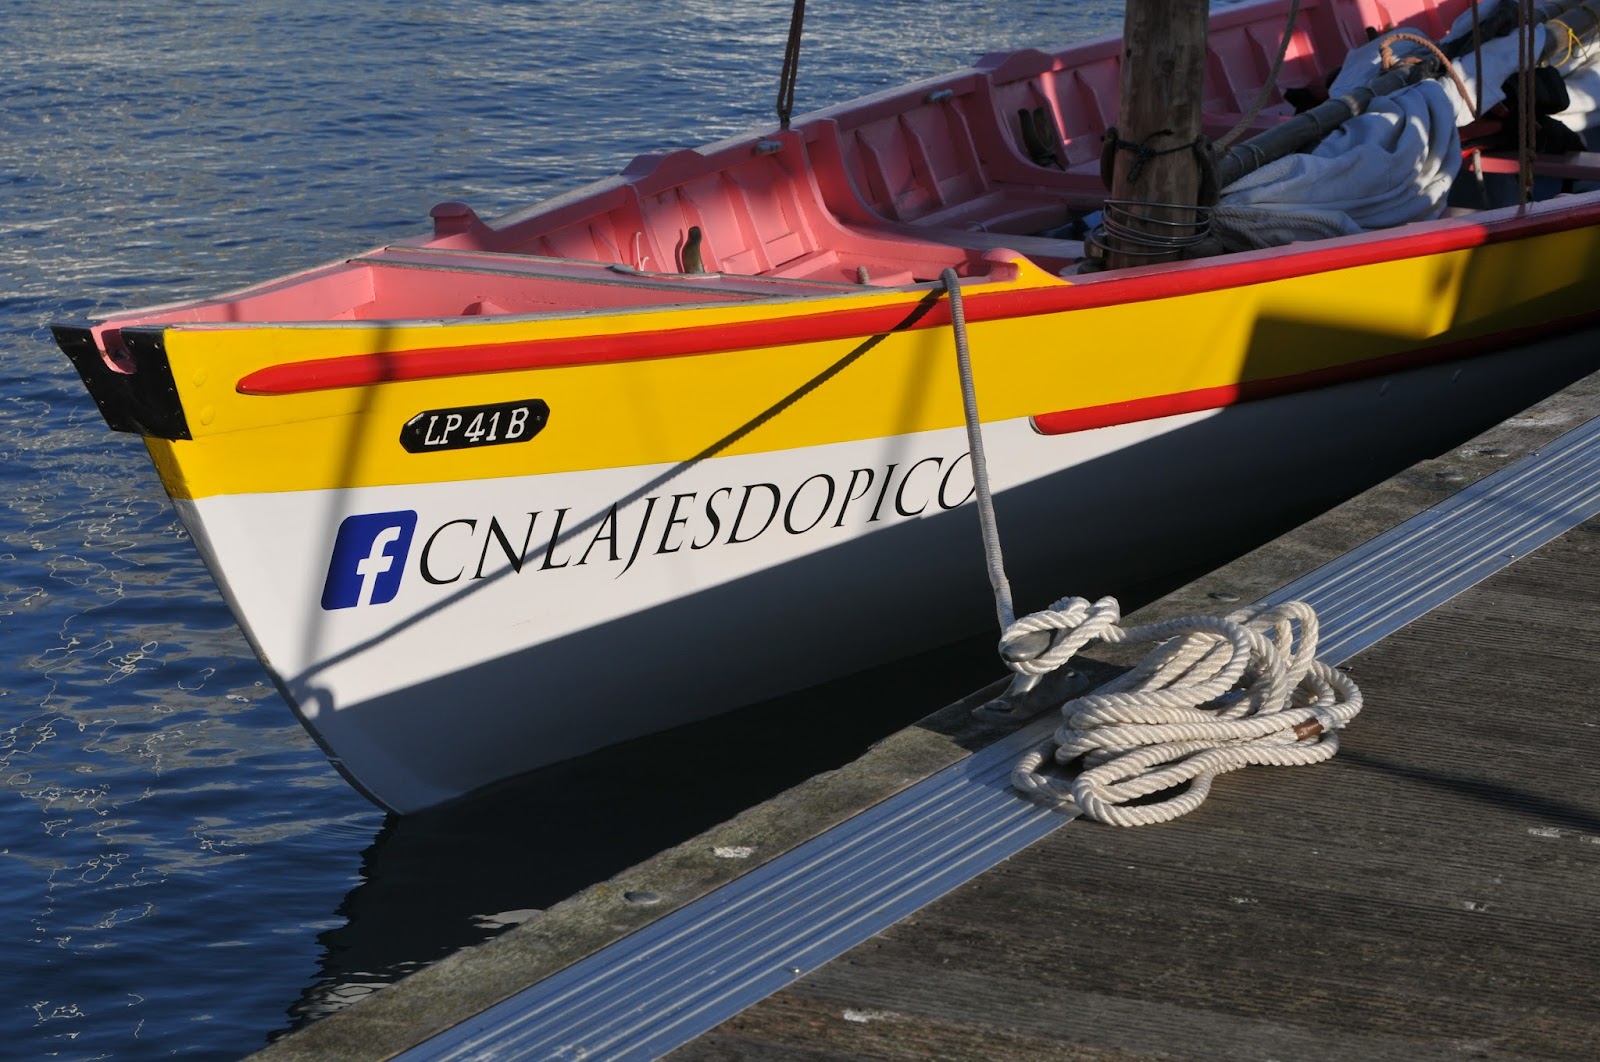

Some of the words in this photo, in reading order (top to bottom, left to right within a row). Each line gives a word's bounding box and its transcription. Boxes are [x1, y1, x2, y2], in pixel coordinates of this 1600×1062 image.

[424, 413, 463, 446] LP
[464, 411, 501, 442] 41
[505, 407, 530, 439] B
[419, 451, 978, 586] CNLAJESDOPICO
